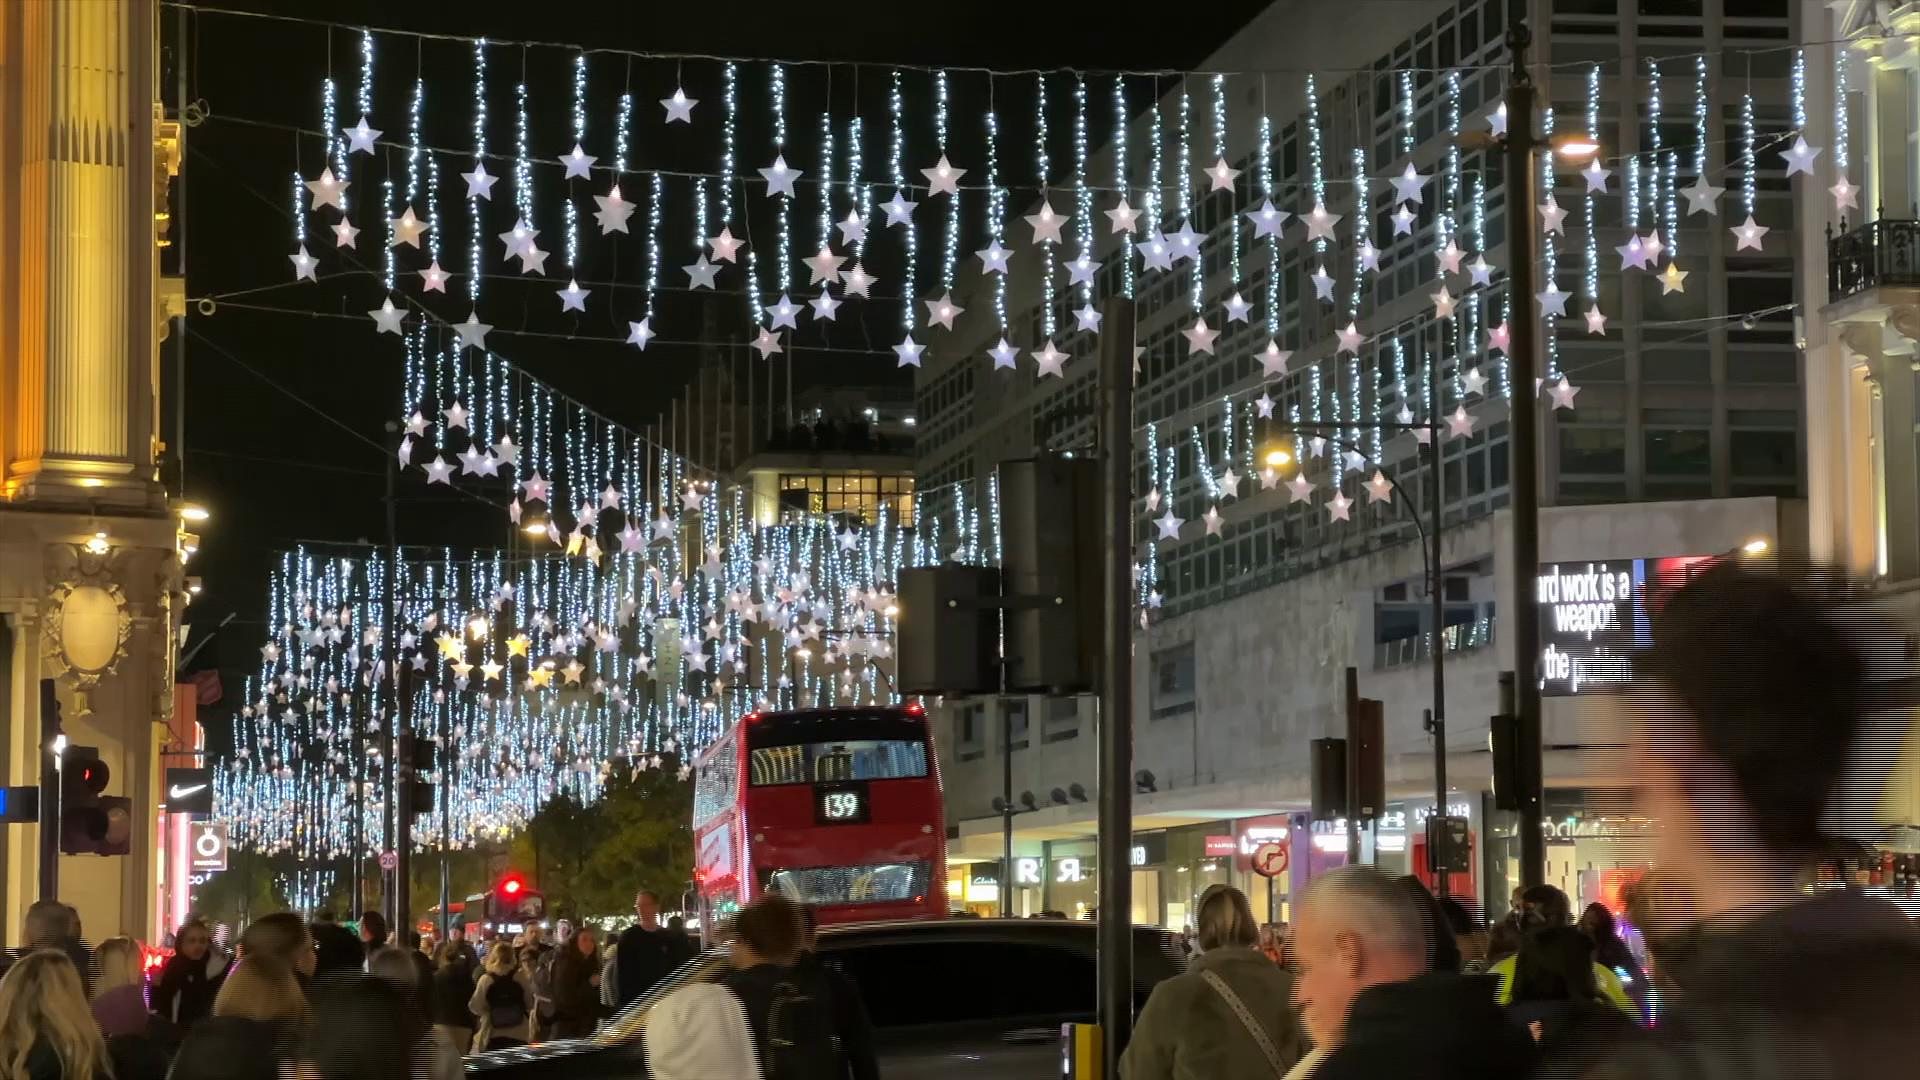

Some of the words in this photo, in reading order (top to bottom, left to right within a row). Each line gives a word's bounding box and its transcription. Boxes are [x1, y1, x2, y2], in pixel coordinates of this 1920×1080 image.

[1561, 564, 1600, 602] work
[1602, 564, 1615, 601] is
[1618, 571, 1631, 600] a
[1555, 602, 1619, 641] weapon
[1544, 643, 1570, 680] the
[824, 793, 858, 818] 139
[383, 857, 394, 865] 20
